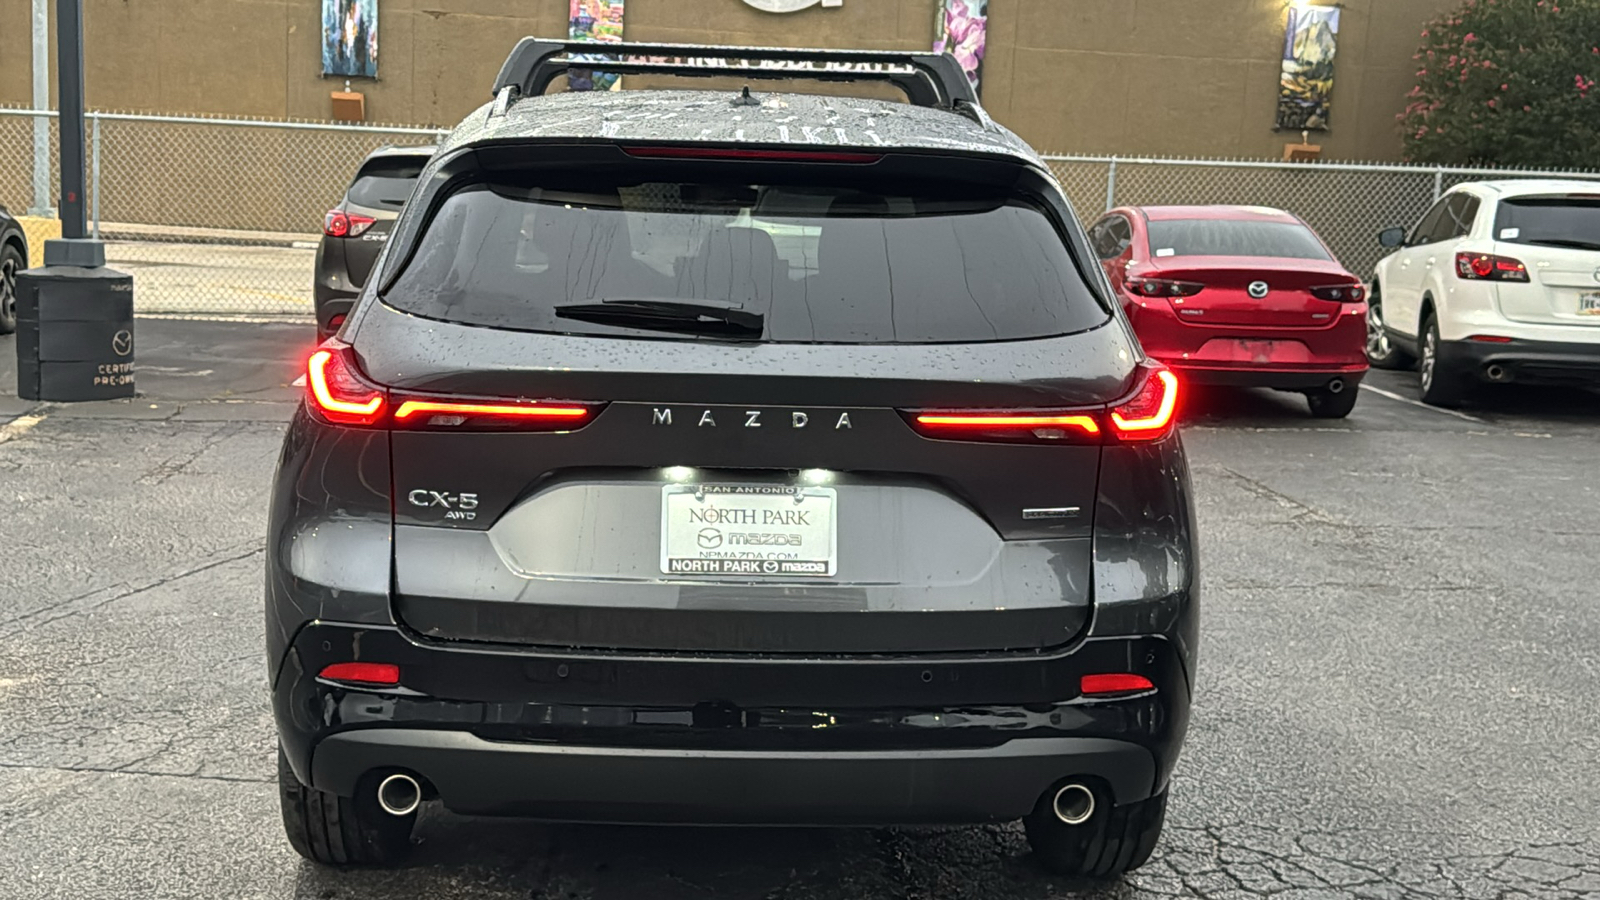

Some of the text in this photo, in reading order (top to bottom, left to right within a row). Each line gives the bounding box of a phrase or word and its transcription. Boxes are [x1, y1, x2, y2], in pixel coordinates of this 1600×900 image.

[652, 408, 852, 429] MAZDA
[735, 486, 796, 494] ANTONIO
[408, 489, 479, 509] CX-5
[444, 510, 477, 520] AWD
[689, 505, 811, 526] NORTH PARK
[728, 532, 802, 546] mazda
[672, 560, 826, 572] NORTH PARK mazda
